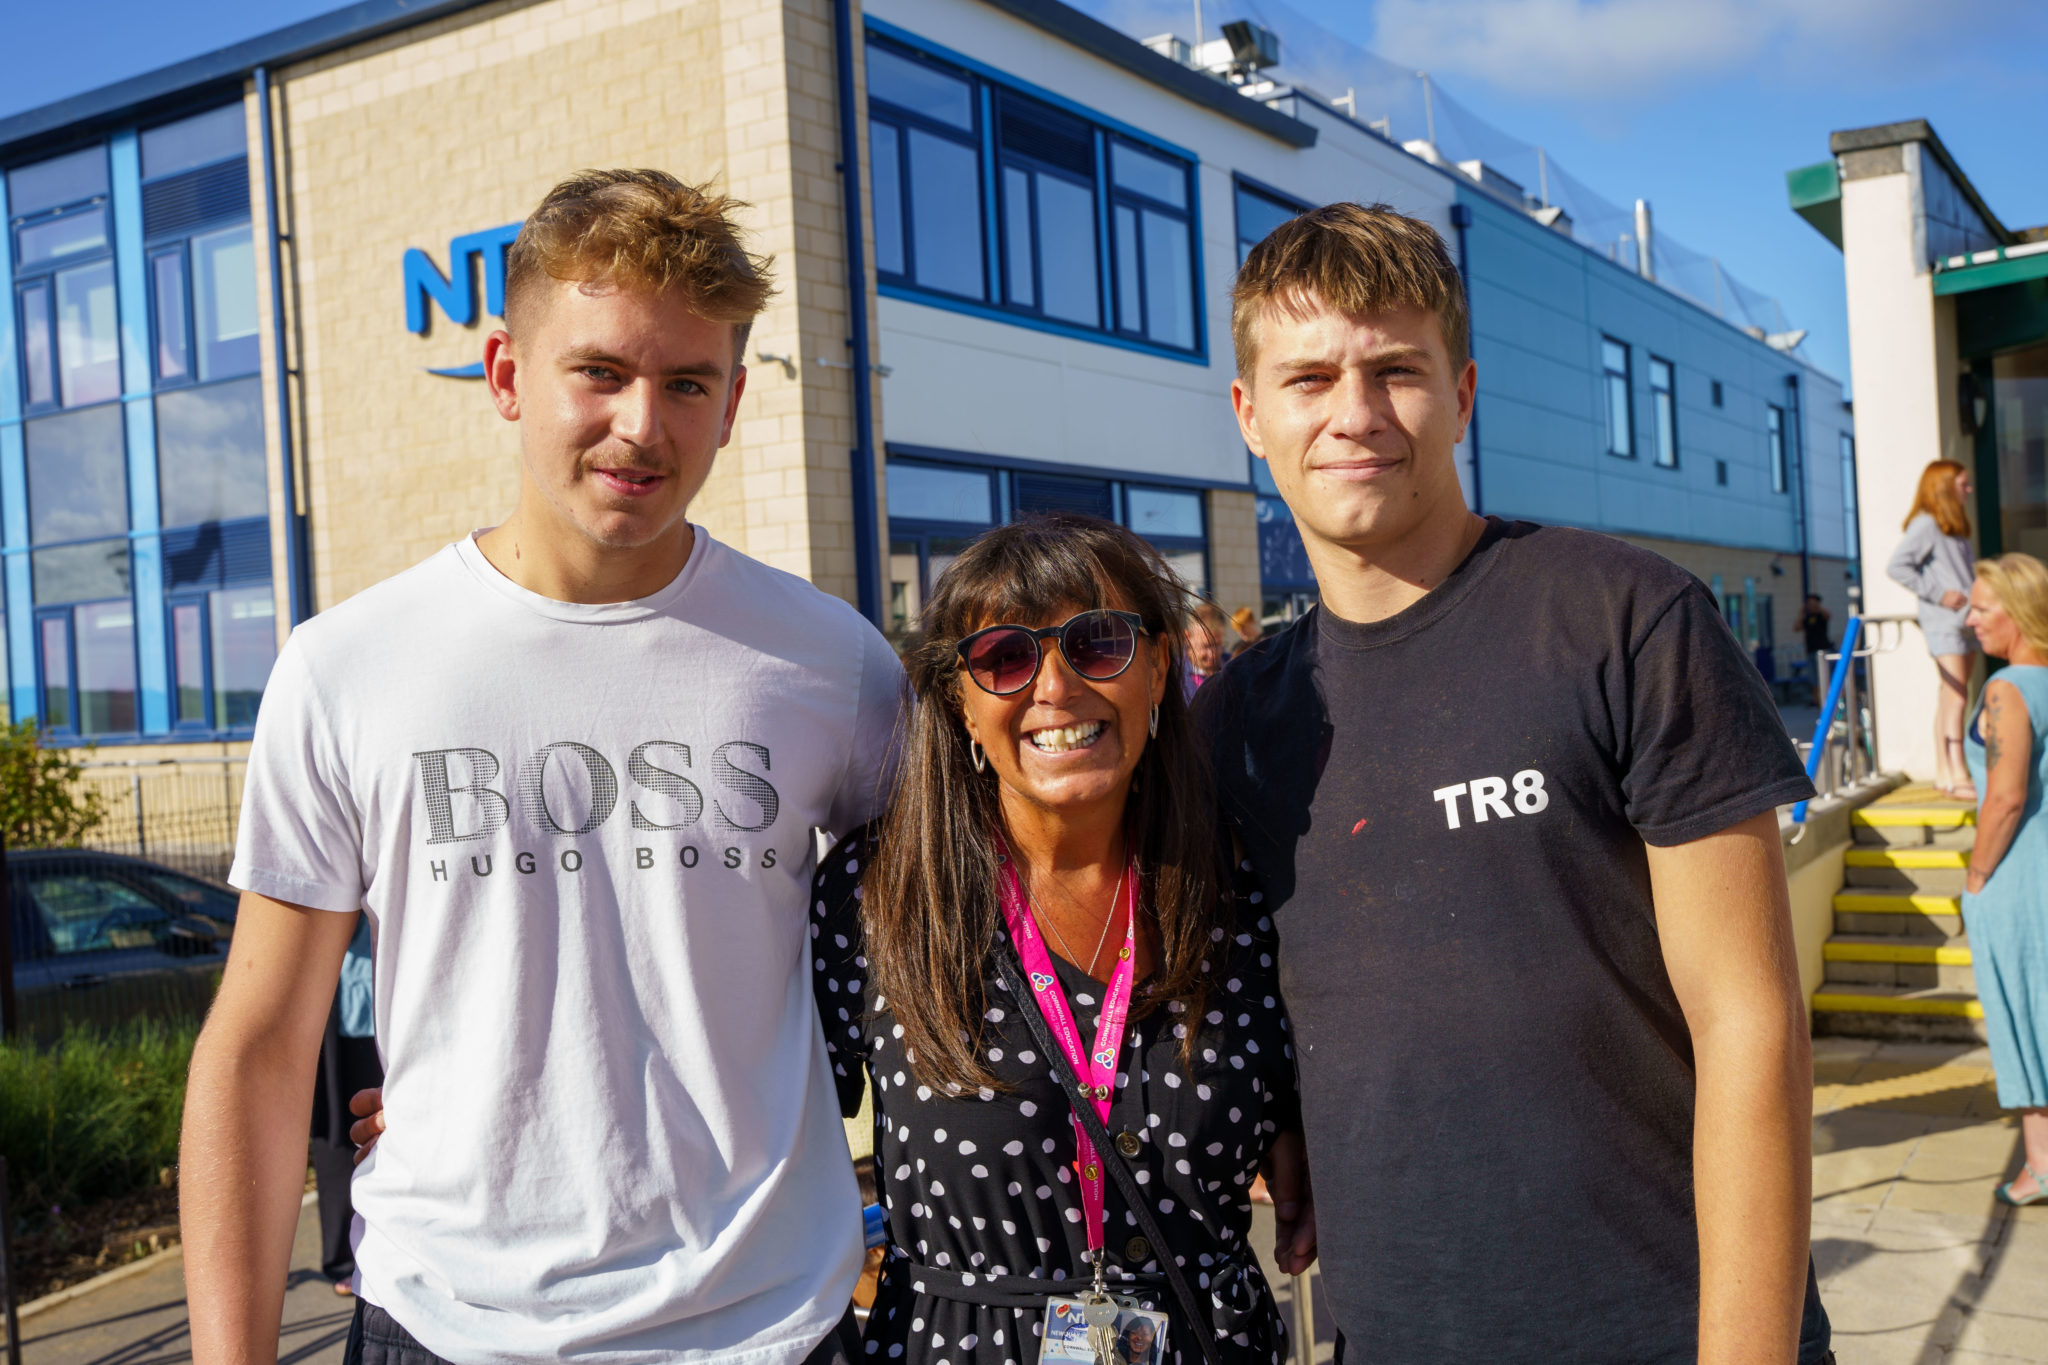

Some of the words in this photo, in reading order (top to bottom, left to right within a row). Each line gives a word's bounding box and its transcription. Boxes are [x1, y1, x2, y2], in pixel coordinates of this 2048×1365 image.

[411, 740, 780, 845] BOSS
[1432, 769, 1549, 830] TR8
[429, 849, 584, 882] HUGO
[635, 845, 777, 870] BOSS
[1049, 990, 1067, 1026] CORNWALL
[1063, 1026, 1079, 1065] EDUCATION
[1100, 1009, 1114, 1047] CORNWALL
[1108, 973, 1124, 1009] EDUCATION
[1091, 1160, 1099, 1201] EATION
